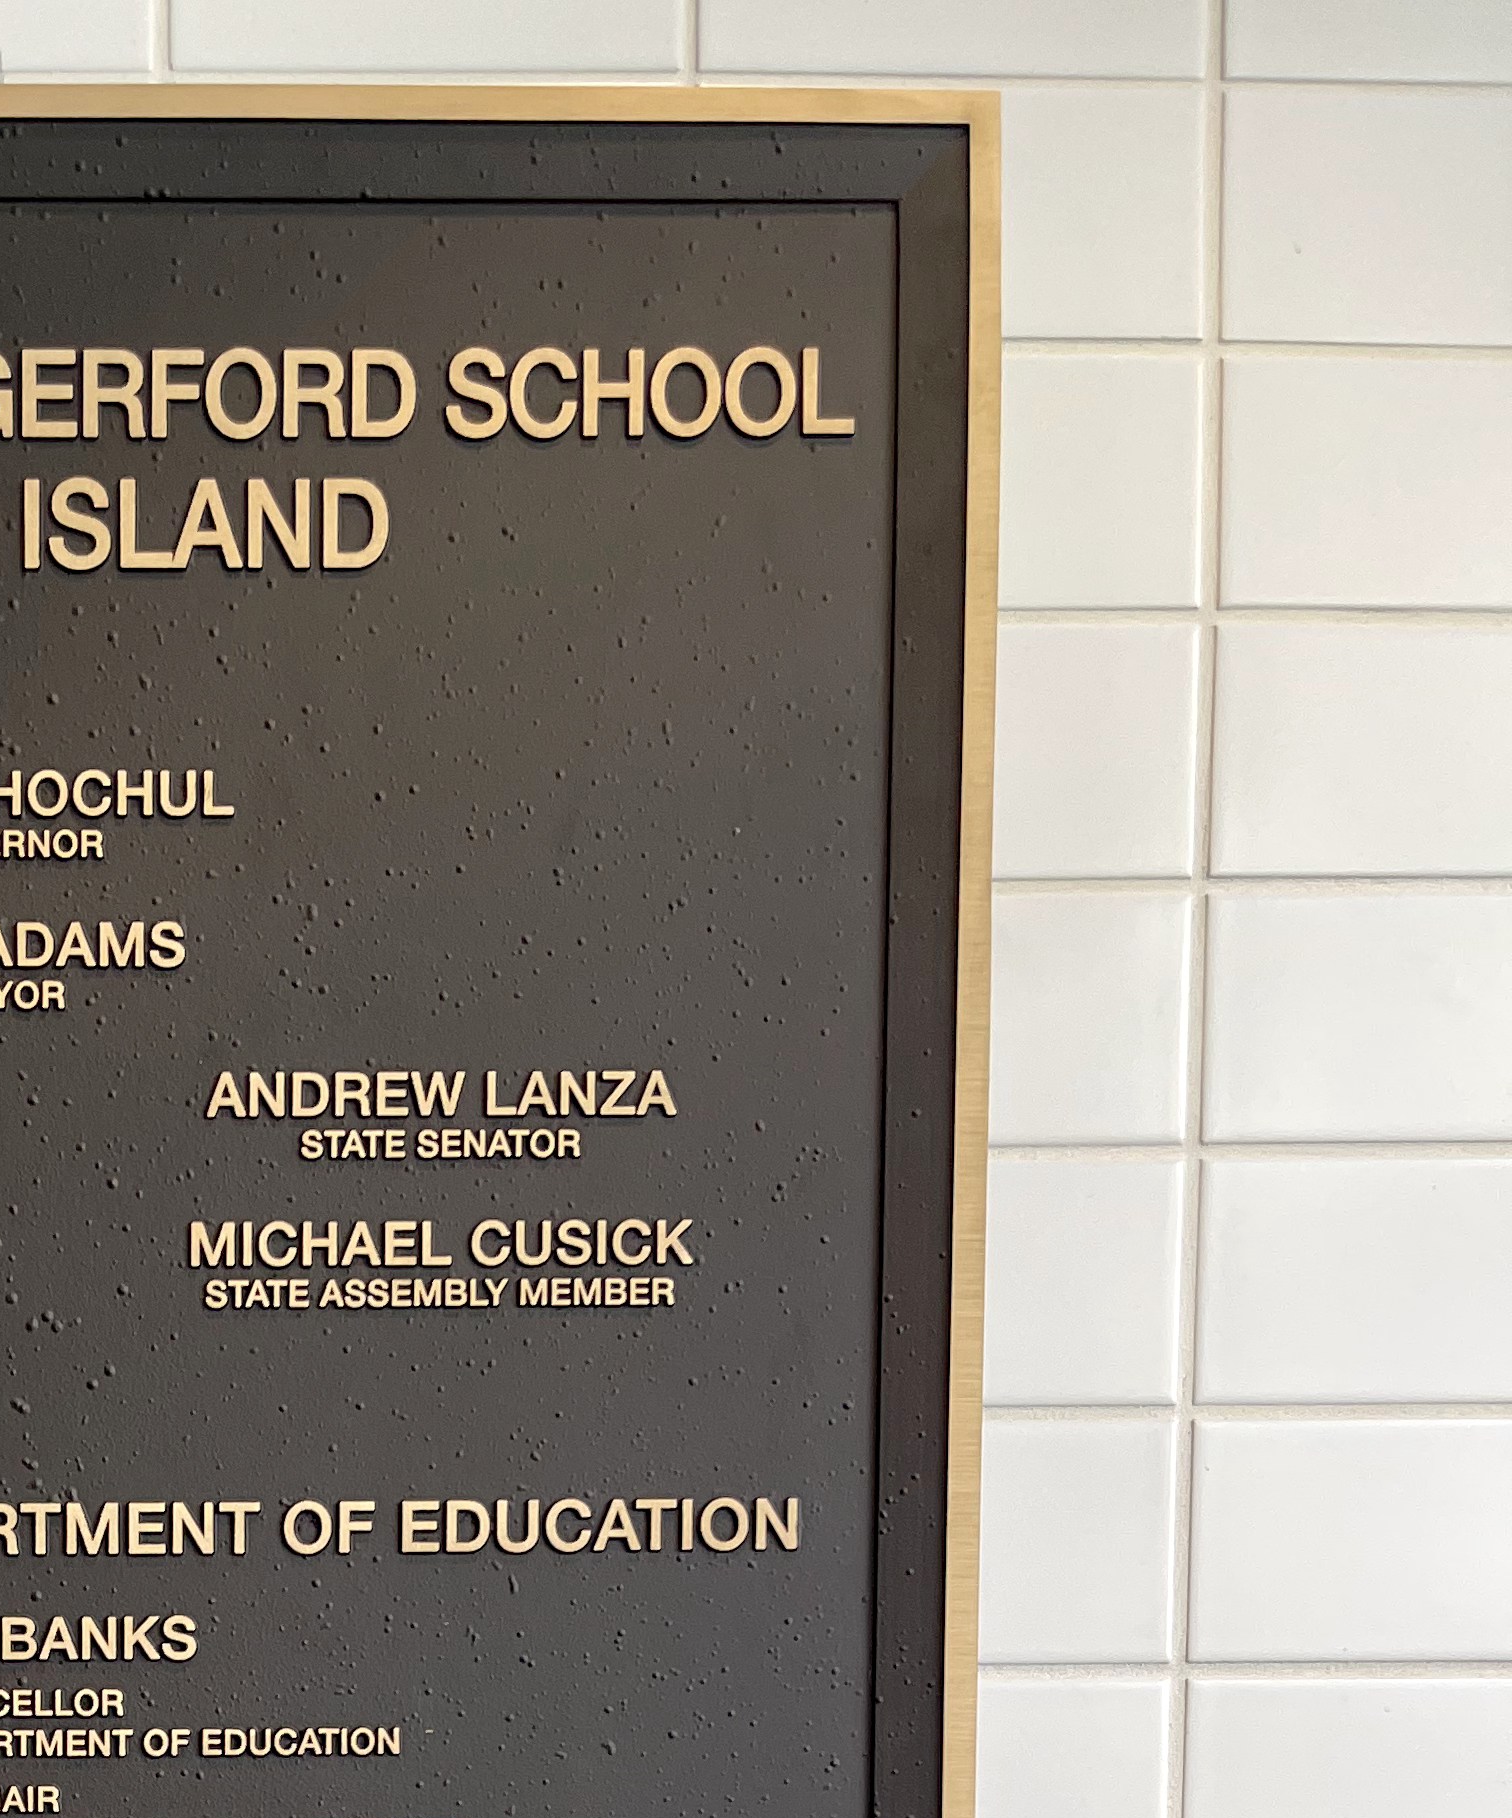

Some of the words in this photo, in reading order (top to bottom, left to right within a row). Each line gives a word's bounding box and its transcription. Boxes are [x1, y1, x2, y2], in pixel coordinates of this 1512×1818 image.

[445, 344, 856, 439] SCHOOL
[23, 476, 390, 571] ISLAND
[206, 1070, 466, 1118] ANDREW
[486, 1069, 678, 1116] LANZA
[300, 1128, 407, 1159] STATE
[416, 1128, 581, 1159] SENATOR
[190, 1220, 453, 1267] MICHAEL
[471, 1218, 694, 1267] CUSICK
[205, 1278, 310, 1309] STATE
[318, 1277, 509, 1309] ASSEMBLY
[519, 1277, 676, 1306] MEMBER
[283, 1499, 376, 1555] OF
[401, 1496, 799, 1553] EDUCATION
[1, 1614, 198, 1661] BANKS
[143, 1728, 191, 1757] OF
[202, 1726, 401, 1756] EDUCATION
